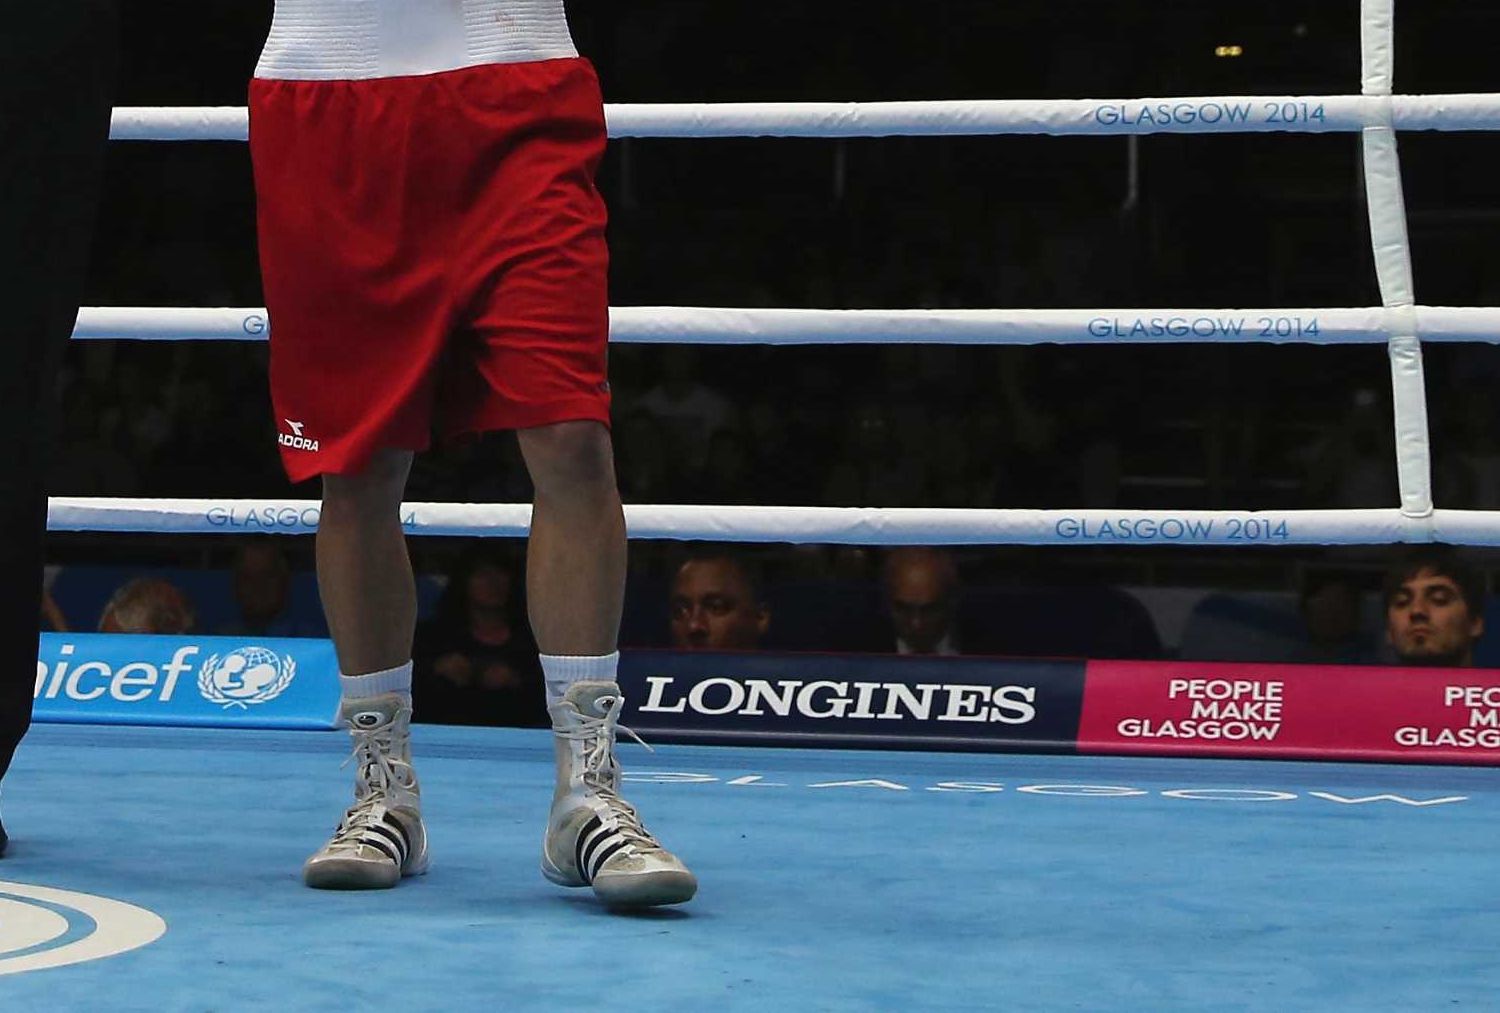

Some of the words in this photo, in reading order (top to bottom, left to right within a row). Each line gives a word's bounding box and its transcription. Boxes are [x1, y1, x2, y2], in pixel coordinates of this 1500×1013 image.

[1095, 103, 1252, 126] GLASGOW
[1264, 102, 1326, 124] 2014
[1088, 317, 1246, 337] GLASGOW
[1258, 317, 1321, 337] 2014
[1055, 518, 1215, 539] GLASGOW
[1226, 518, 1290, 540] 2014
[638, 675, 1037, 725] LONGINES
[1168, 679, 1284, 701] PEOPLE
[1191, 700, 1283, 722] MAKE
[1117, 718, 1281, 741] GLASGOW
